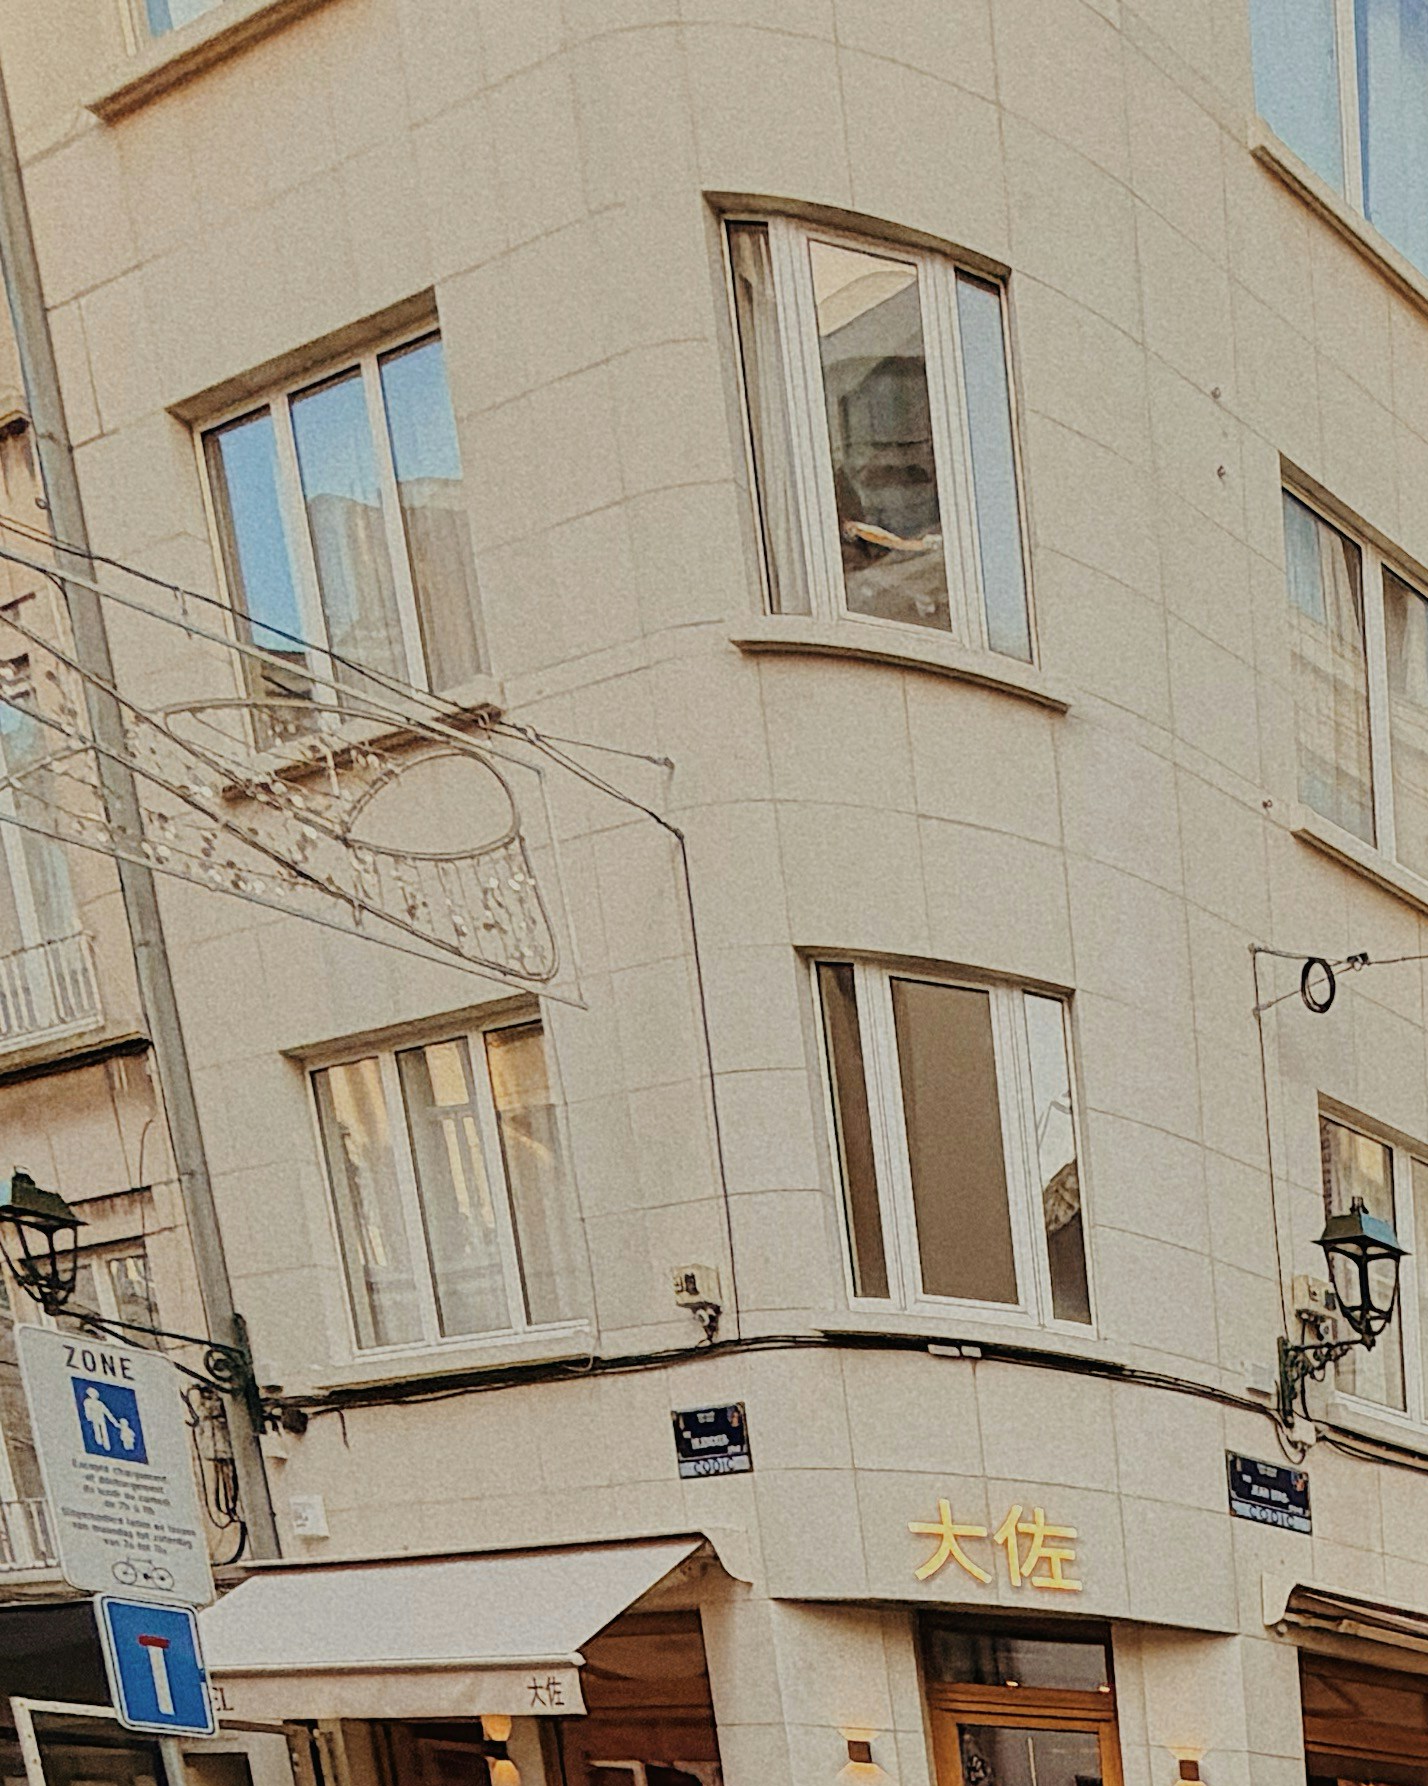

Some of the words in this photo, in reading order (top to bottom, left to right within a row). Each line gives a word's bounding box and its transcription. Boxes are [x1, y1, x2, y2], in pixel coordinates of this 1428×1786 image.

[62, 1344, 135, 1381] ZONE
[908, 1497, 1083, 1592] 大佐
[526, 1676, 565, 1708] 大佐
